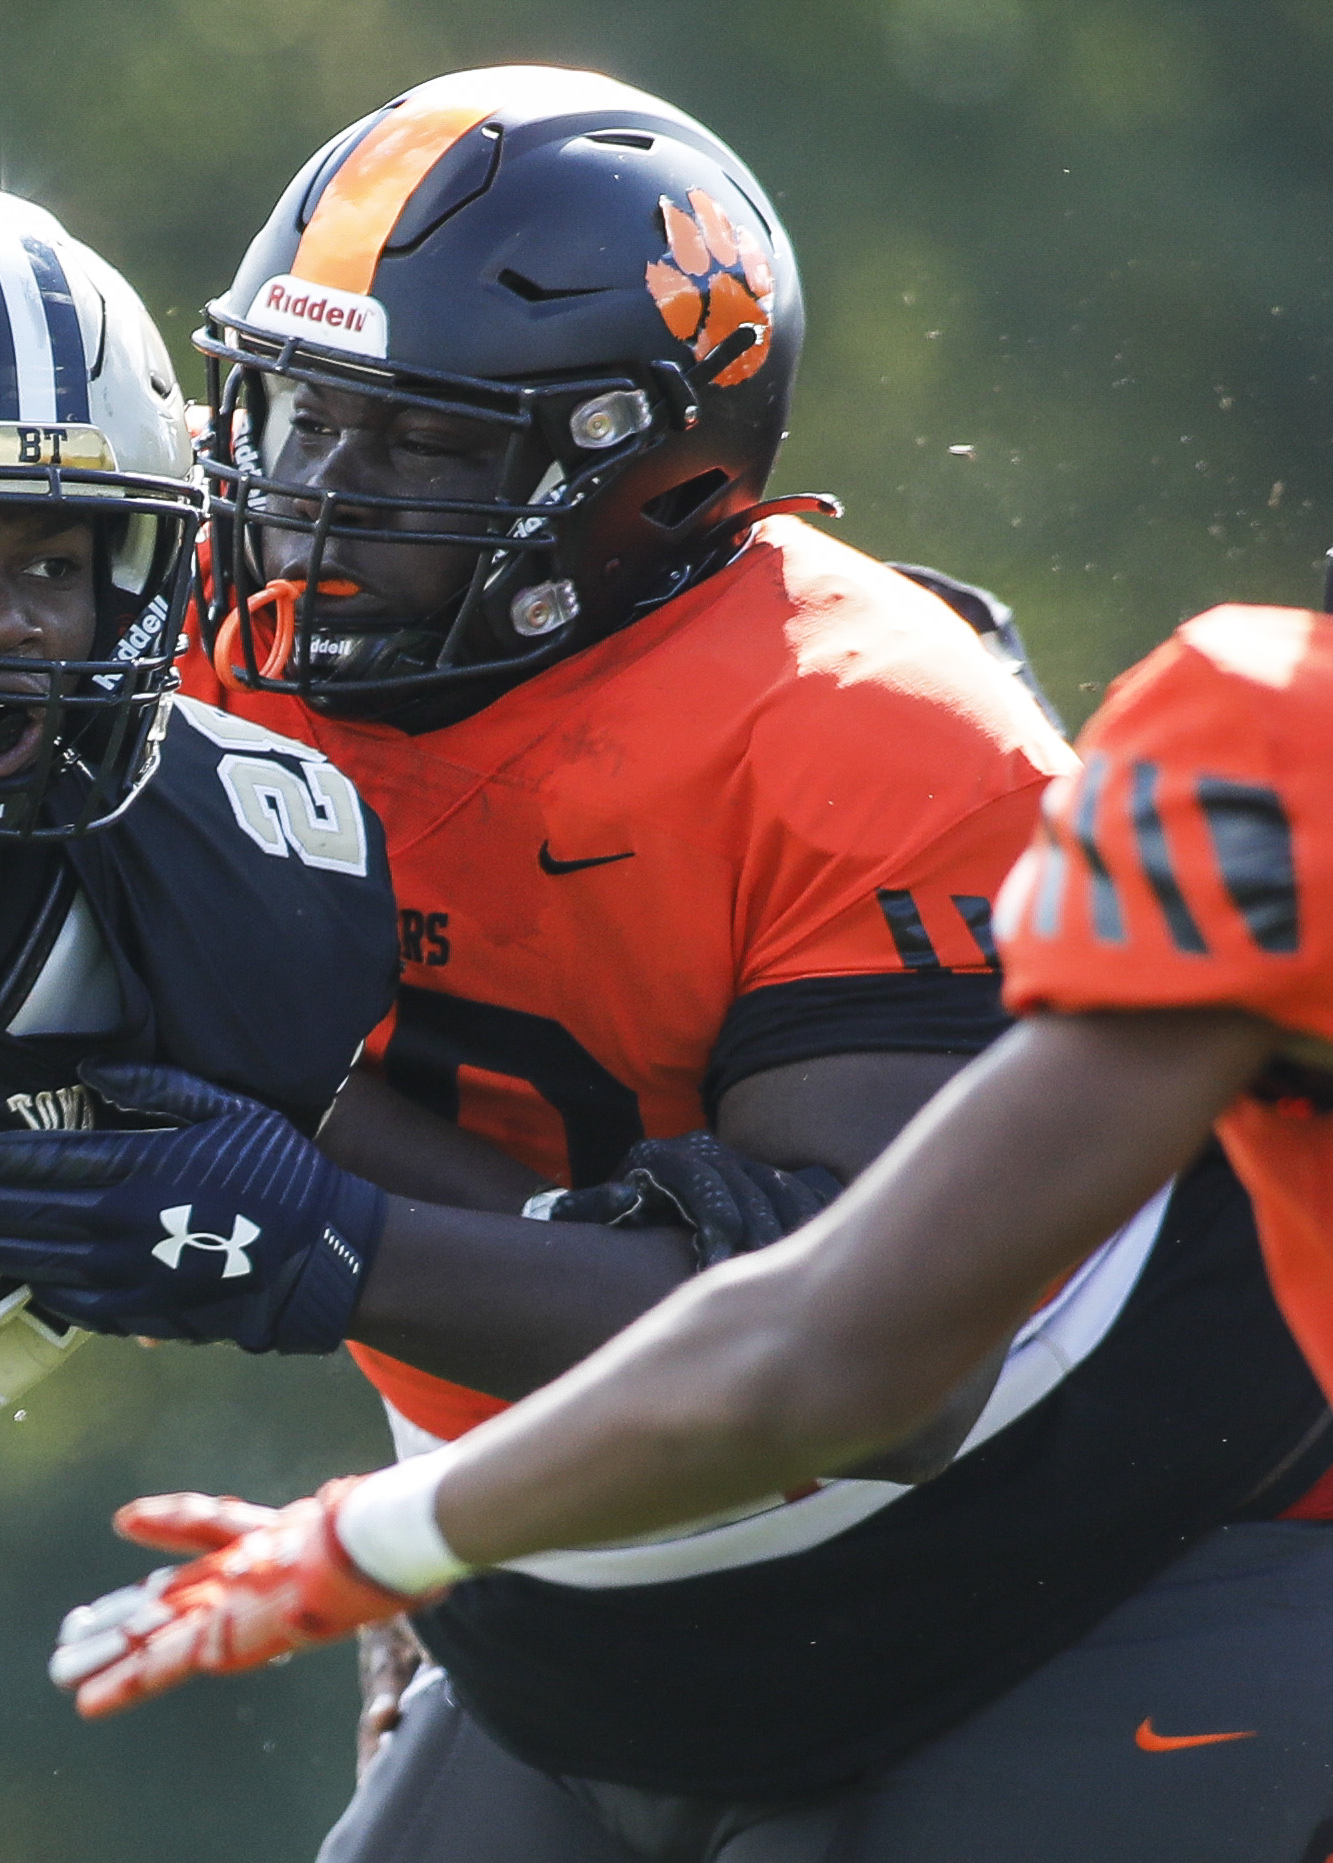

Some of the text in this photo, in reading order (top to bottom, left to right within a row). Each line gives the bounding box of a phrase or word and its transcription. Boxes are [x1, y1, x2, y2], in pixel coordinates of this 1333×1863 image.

[267, 284, 368, 332] Riddell
[16, 427, 68, 464] BT
[91, 594, 169, 691] Rddell
